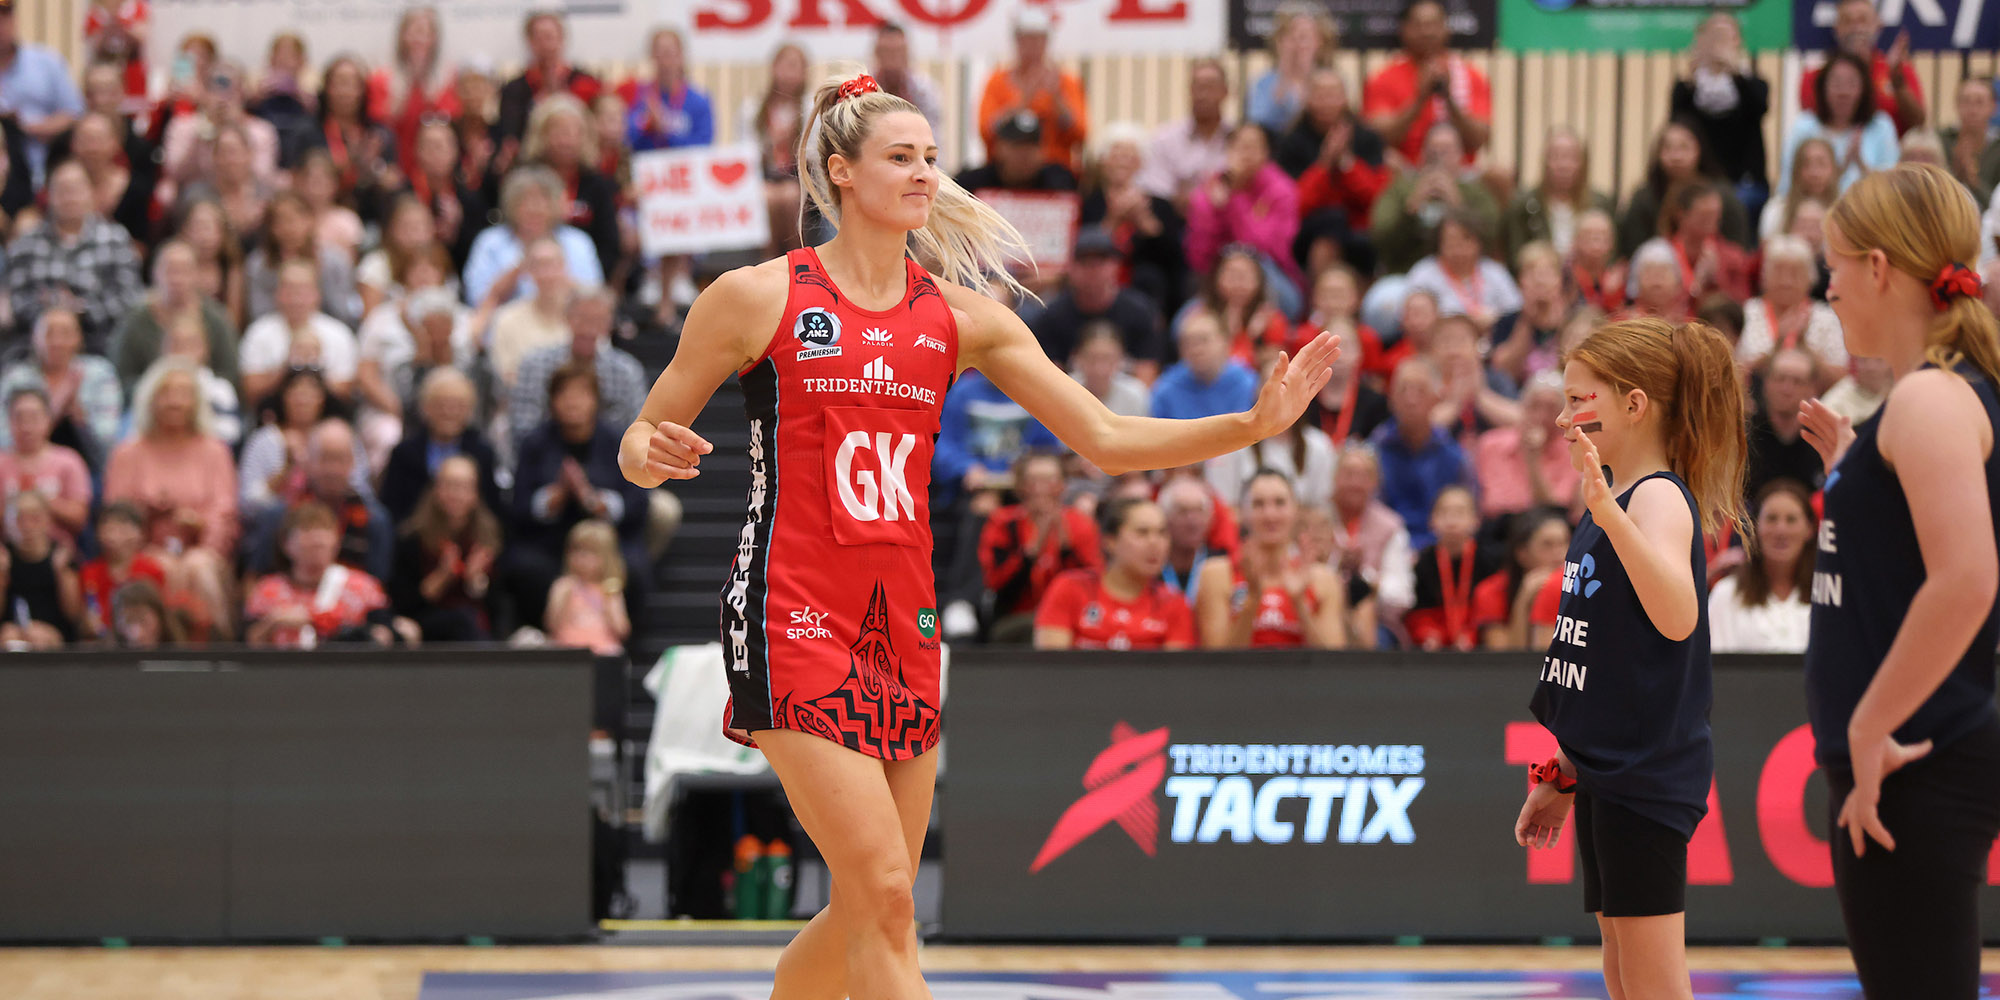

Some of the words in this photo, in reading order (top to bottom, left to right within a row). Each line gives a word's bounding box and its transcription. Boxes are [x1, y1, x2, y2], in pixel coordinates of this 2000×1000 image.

[806, 329, 829, 338] ANZ
[925, 339, 947, 354] TACTIX
[798, 348, 841, 360] PREMIERSHIP
[803, 378, 937, 405] TRIDENTHOMES
[834, 430, 916, 522] GK
[1169, 744, 1426, 774] TRIDENTHOMES
[1165, 776, 1426, 844] TACTIX
